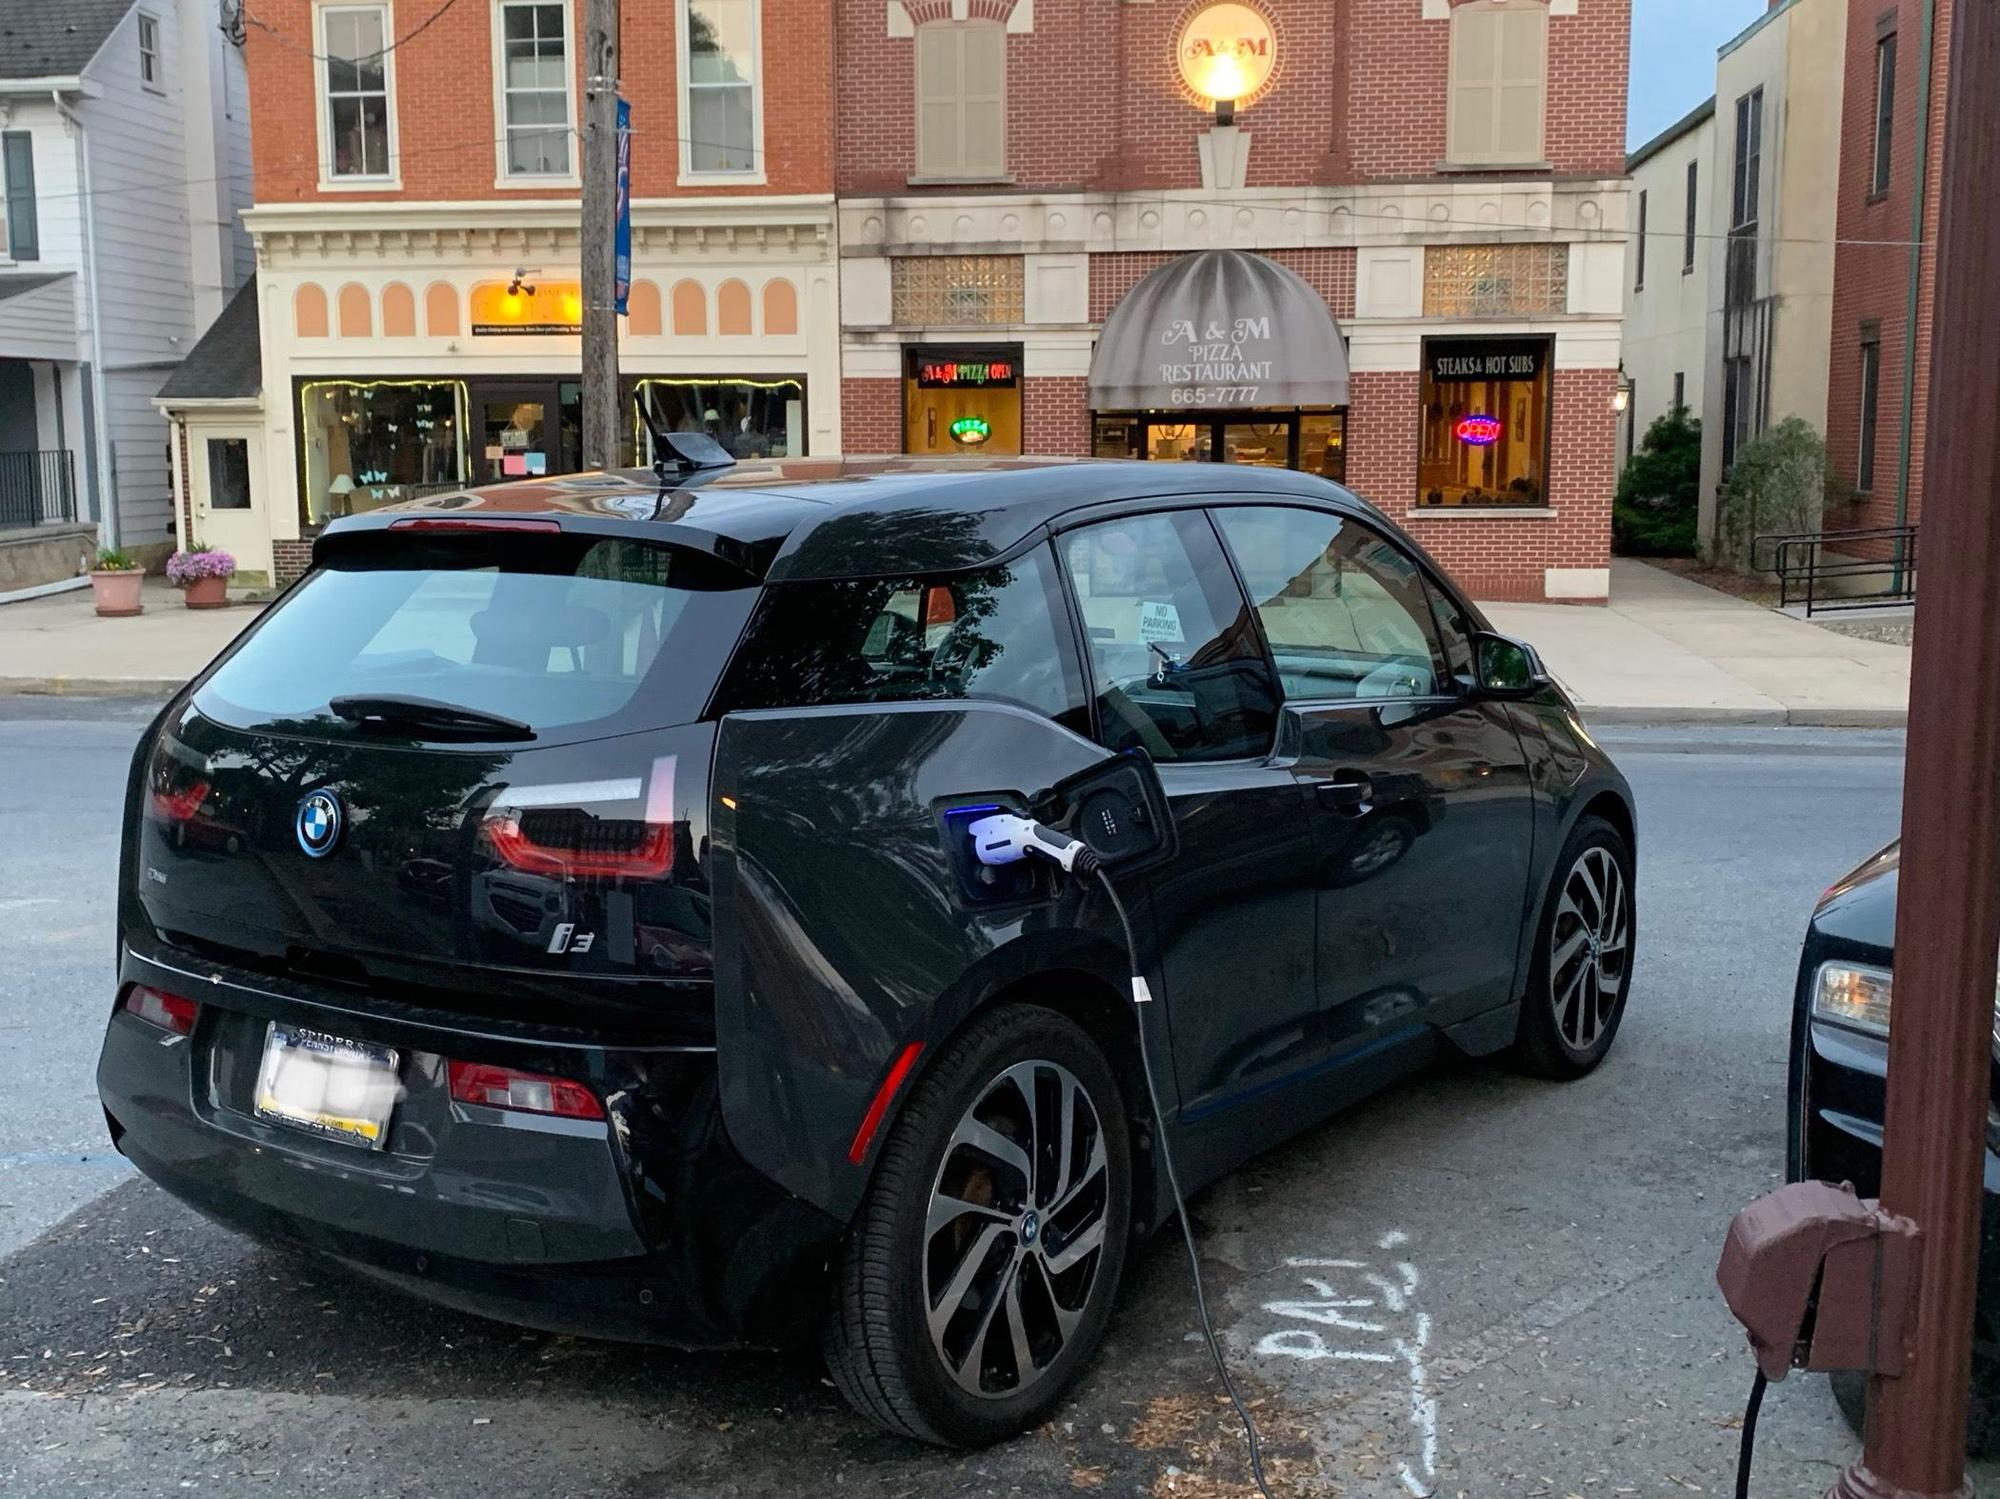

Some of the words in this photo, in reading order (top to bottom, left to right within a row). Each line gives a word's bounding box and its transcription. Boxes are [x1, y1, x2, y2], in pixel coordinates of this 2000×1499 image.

[1184, 38, 1215, 60] A
[1232, 37, 1269, 59] M
[1161, 319, 1198, 345] A
[1205, 321, 1226, 340] &
[1231, 316, 1271, 344] M
[1188, 344, 1243, 362] PIZZA
[1160, 361, 1273, 384] RESTAURANT
[1437, 357, 1474, 376] STEAKS
[1485, 355, 1507, 374] HOT
[1508, 354, 1534, 374] SUBS
[1171, 386, 1260, 405] 665-7777
[1457, 421, 1501, 440] OPEN
[1155, 604, 1168, 618] NO
[1142, 616, 1177, 631] PARKING
[547, 923, 595, 954] i3
